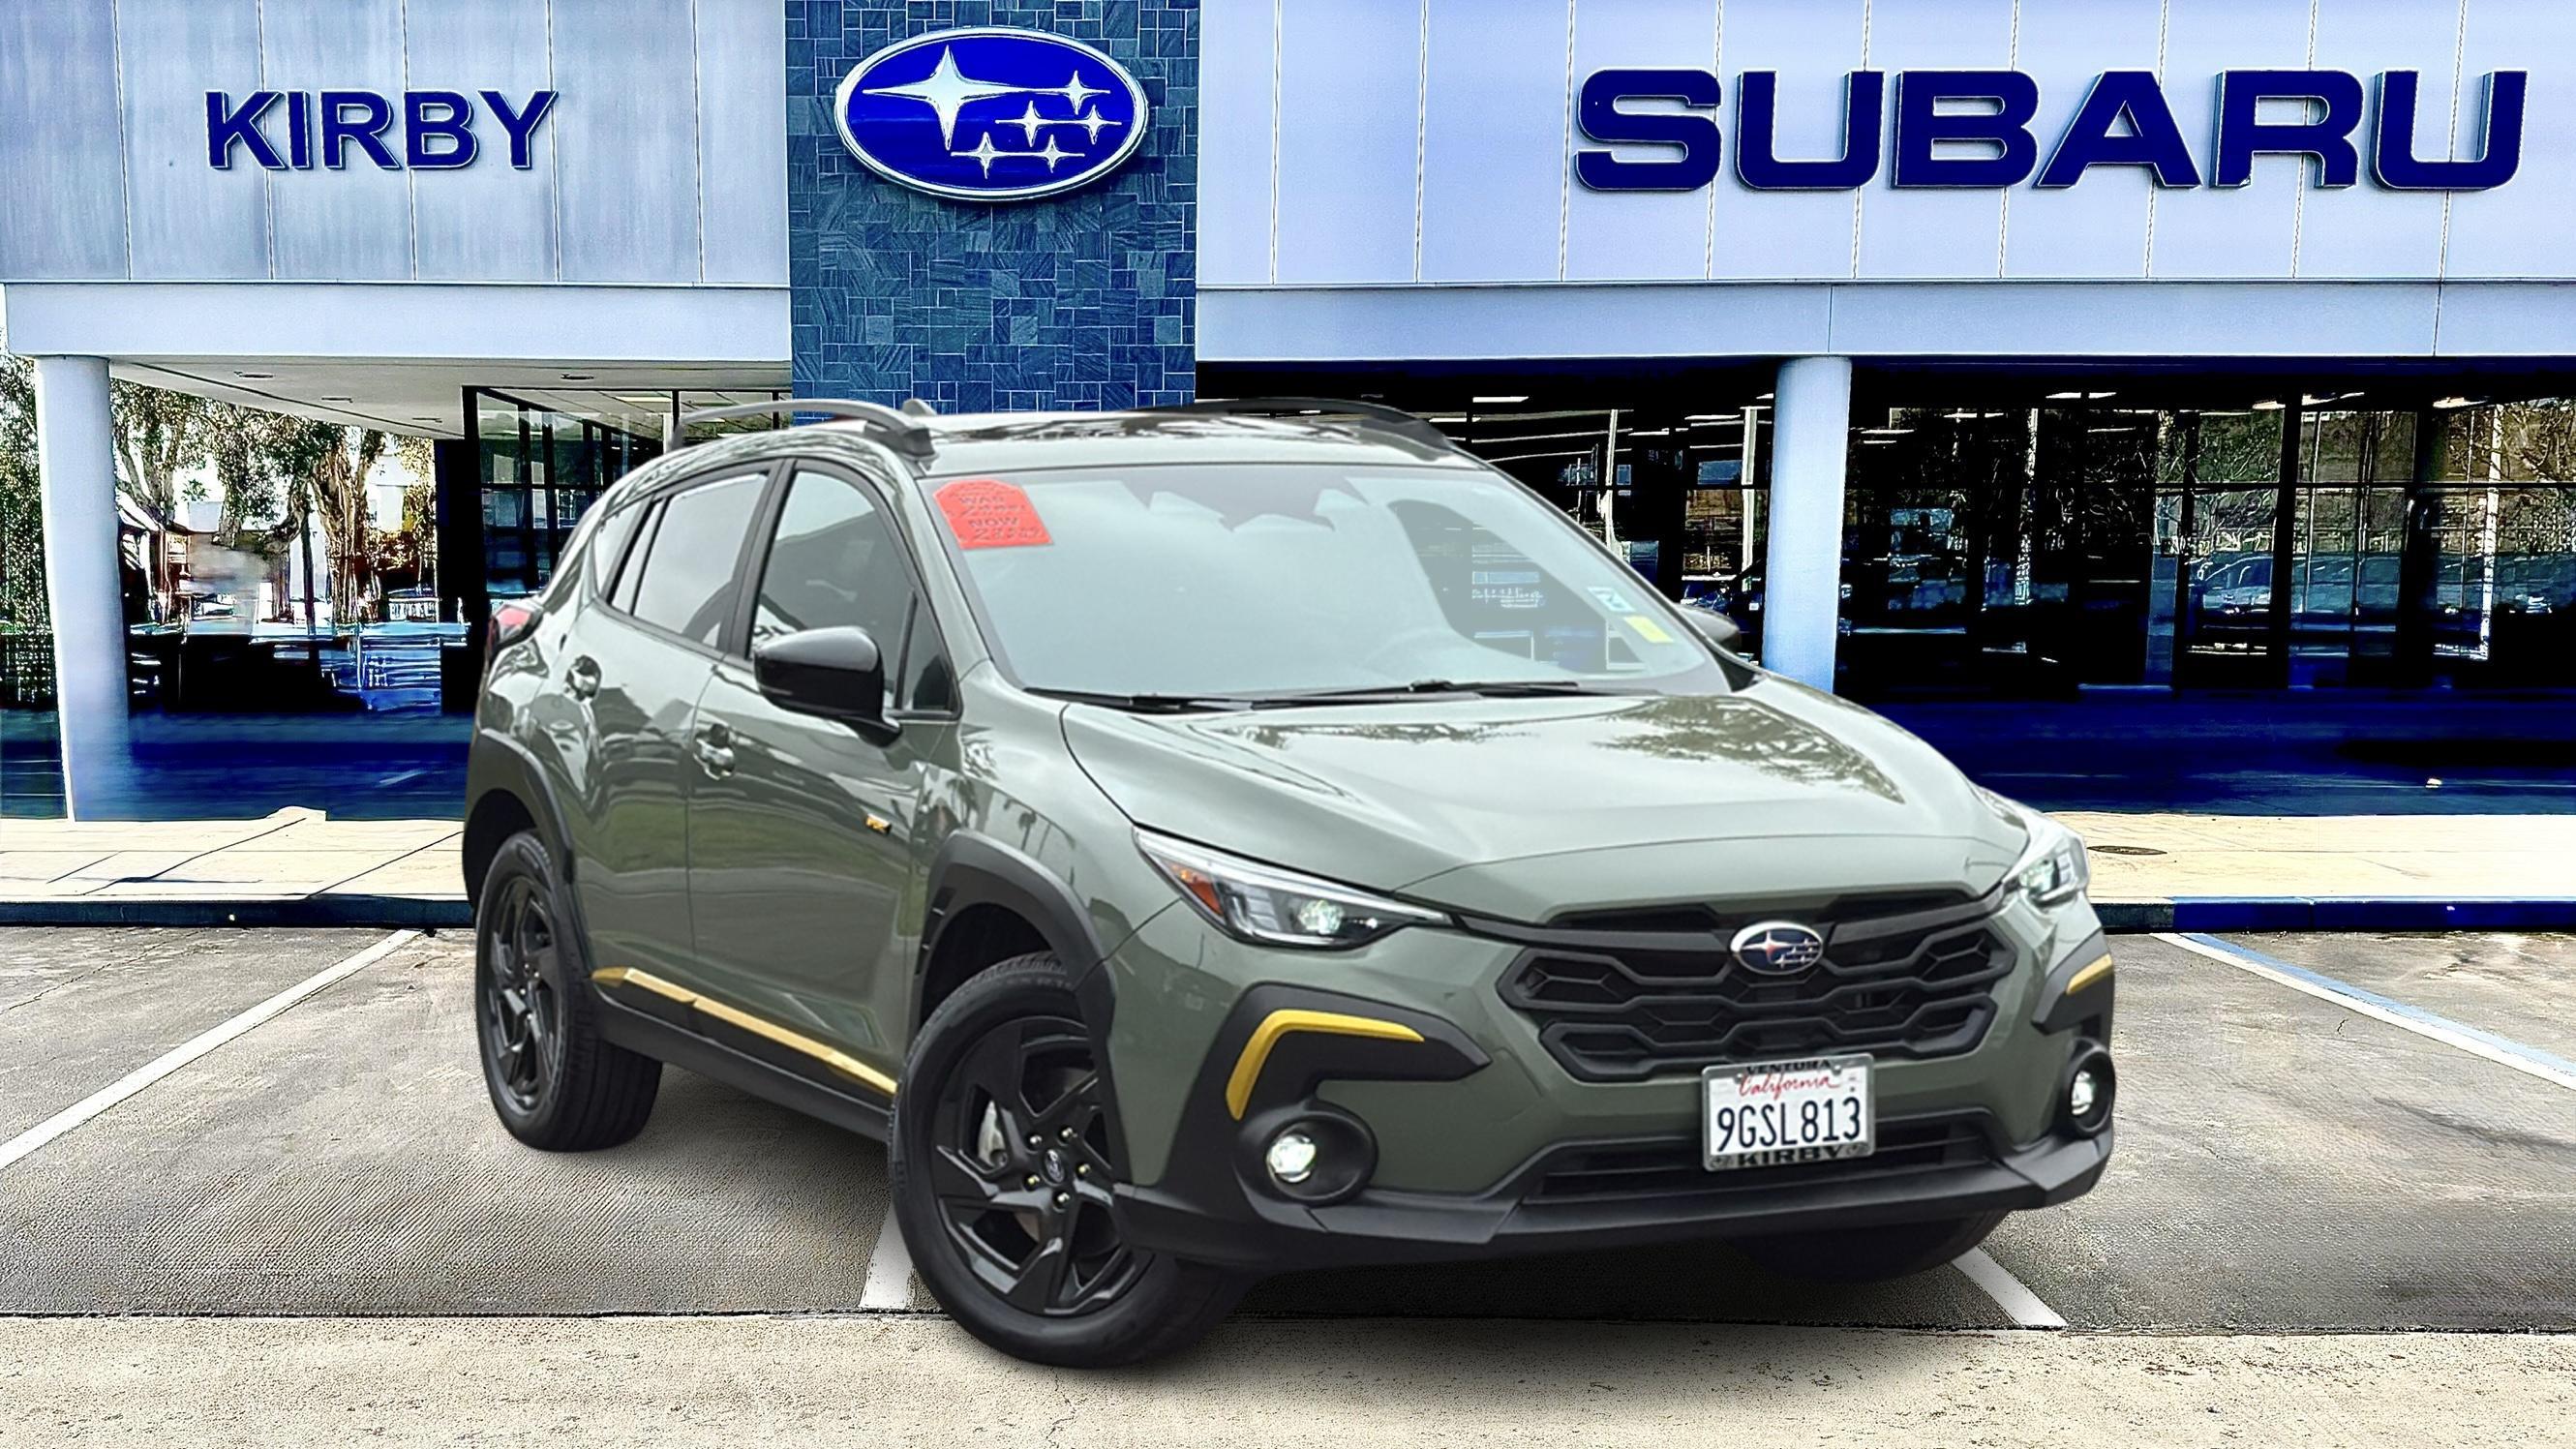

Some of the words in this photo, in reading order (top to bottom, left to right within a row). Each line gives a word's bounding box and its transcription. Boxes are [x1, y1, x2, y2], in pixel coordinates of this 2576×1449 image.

[205, 90, 559, 169] KIRBY
[1575, 69, 2529, 191] SUBARU
[968, 517, 1018, 528] NOW
[1746, 1059, 1833, 1074] VENTURA
[1739, 1072, 1841, 1101] California
[1716, 1097, 1862, 1153] 9GSL813
[1738, 1145, 1842, 1166] KIRBY
